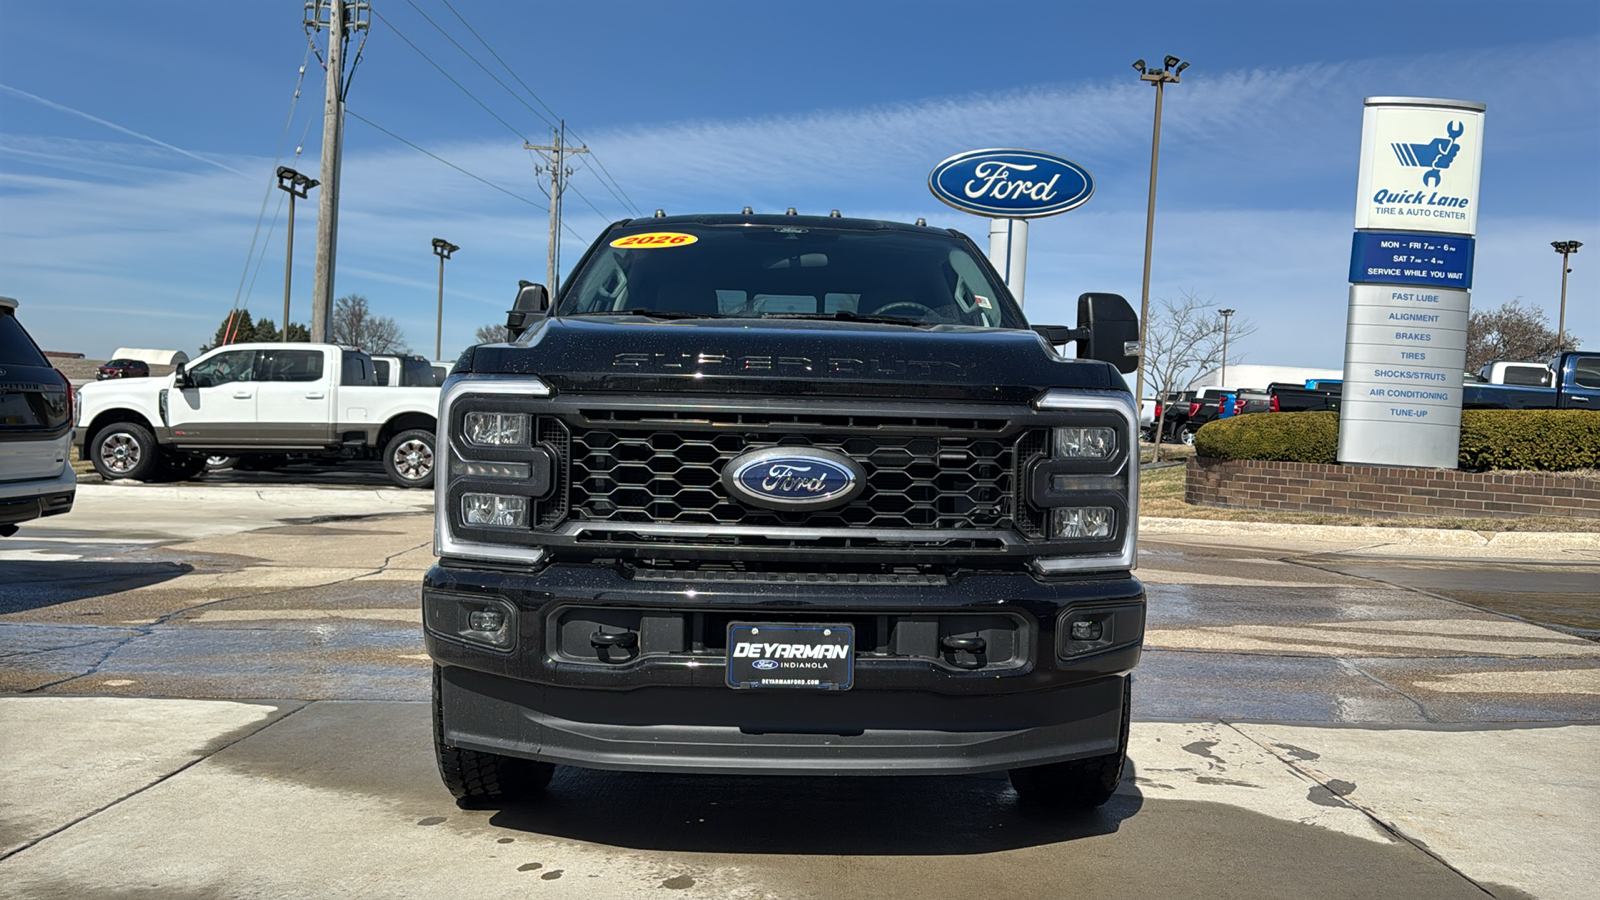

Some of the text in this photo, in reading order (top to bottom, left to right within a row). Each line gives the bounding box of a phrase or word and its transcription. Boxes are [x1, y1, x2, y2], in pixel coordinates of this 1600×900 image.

[964, 161, 1061, 202] Ford
[1373, 188, 1469, 209] Quick Lane
[1375, 207, 1466, 220] TIRE & AUTO CENTER
[618, 235, 689, 246] 2026
[1380, 241, 1400, 249] MON
[1409, 242, 1421, 250] FRI
[1393, 255, 1408, 263] SAT
[1367, 267, 1463, 280] SERVICE WHILE YOU WAIT
[1391, 292, 1439, 303] FAST LUBE
[1388, 312, 1439, 323] ALIGNMENT
[1395, 332, 1432, 342] BRAKES
[1400, 351, 1426, 361] TIRES
[611, 352, 977, 377] SUPER DUTY
[1374, 369, 1446, 381] SHOCKS/STRUTS
[1369, 388, 1448, 401] AIR CONDITIONING
[1390, 408, 1428, 418] TUNE-UP
[761, 464, 828, 492] Ford
[732, 642, 850, 659] DEYARMAN
